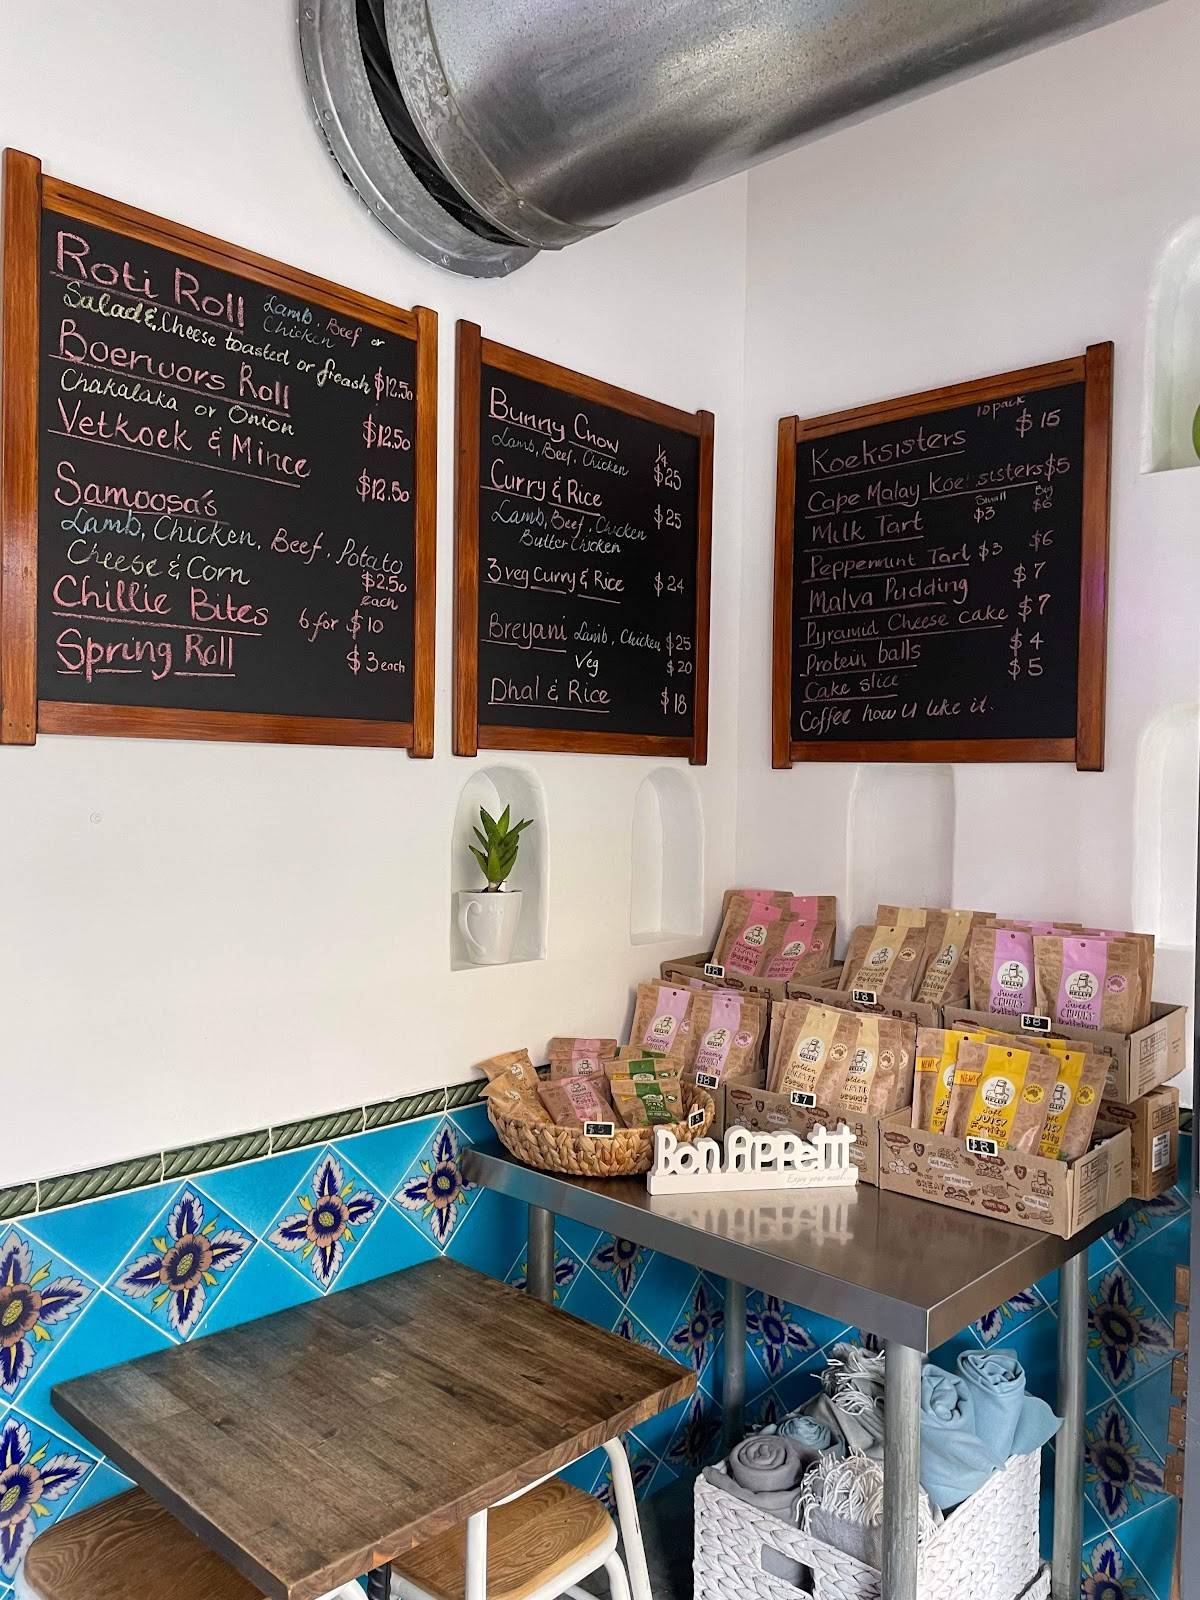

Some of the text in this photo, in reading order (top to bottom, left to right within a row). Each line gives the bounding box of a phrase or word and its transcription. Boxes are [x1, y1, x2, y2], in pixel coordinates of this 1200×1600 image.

[56, 231, 246, 327] Roti Roll
[63, 280, 142, 324] Salad
[158, 311, 217, 347] Cheese
[224, 331, 290, 366] toasted
[296, 358, 316, 373] or
[316, 358, 372, 395] freash
[374, 366, 414, 401] $12.50
[263, 315, 336, 349] Chicken
[325, 317, 362, 348] Beef
[370, 338, 386, 347] or
[60, 368, 296, 437] Chakalaka or Onion
[238, 361, 290, 410] Roll
[57, 397, 412, 480] Vetkoek & Mince $12.50
[490, 386, 619, 454] Bunny Chow
[491, 427, 539, 457] Lamb,
[582, 449, 629, 476] Chicken
[812, 426, 967, 477] Koeksisters
[355, 467, 411, 503] $12.50
[490, 458, 603, 507] Curry & Rice
[653, 464, 682, 491] $25
[807, 491, 860, 515] Cape
[867, 481, 920, 508] Malay
[1044, 453, 1071, 481] $5
[975, 485, 1054, 506] Small Big
[491, 499, 548, 529] Lamb,
[595, 516, 648, 541] Chicken
[654, 504, 682, 529] $25
[812, 519, 866, 545] Milk
[874, 511, 924, 537] Tart
[61, 507, 146, 542] Lamb,
[335, 538, 404, 575] Potato
[519, 529, 622, 554] Butter Chicken
[810, 530, 1055, 581] Peppermint Tart $3 $6
[67, 538, 251, 586] Cheese & Corn
[361, 570, 408, 594] $2.50
[487, 557, 685, 598] 3 veg Curry & Rice $24
[52, 573, 172, 615] Chillie
[190, 586, 270, 627] Bites
[299, 607, 309, 631] 6
[307, 606, 340, 643] for
[360, 595, 400, 611] each
[809, 588, 873, 614] Malva
[885, 577, 969, 604] Pudding
[489, 612, 568, 650] Breyani
[620, 628, 661, 652] Chicken
[665, 632, 692, 657] $25
[806, 616, 880, 649] Pyramid
[888, 613, 949, 633] Cheese
[958, 604, 1009, 624] cake
[56, 628, 172, 683] Spring
[184, 632, 234, 670] Roll
[380, 656, 405, 675] each
[574, 651, 693, 677] Veg $20
[806, 653, 867, 676] Protein
[878, 639, 921, 663] balls
[490, 675, 687, 715] Dhal & Rice $18
[805, 679, 850, 702] Cake
[859, 672, 899, 693] slice
[800, 707, 851, 736] Coffee
[862, 702, 897, 722] how
[926, 699, 961, 716] like
[997, 989, 1024, 1000] Sweet
[1065, 1000, 1093, 1010] Sweet
[845, 1076, 868, 1085] olden
[653, 1125, 721, 1176] Bon
